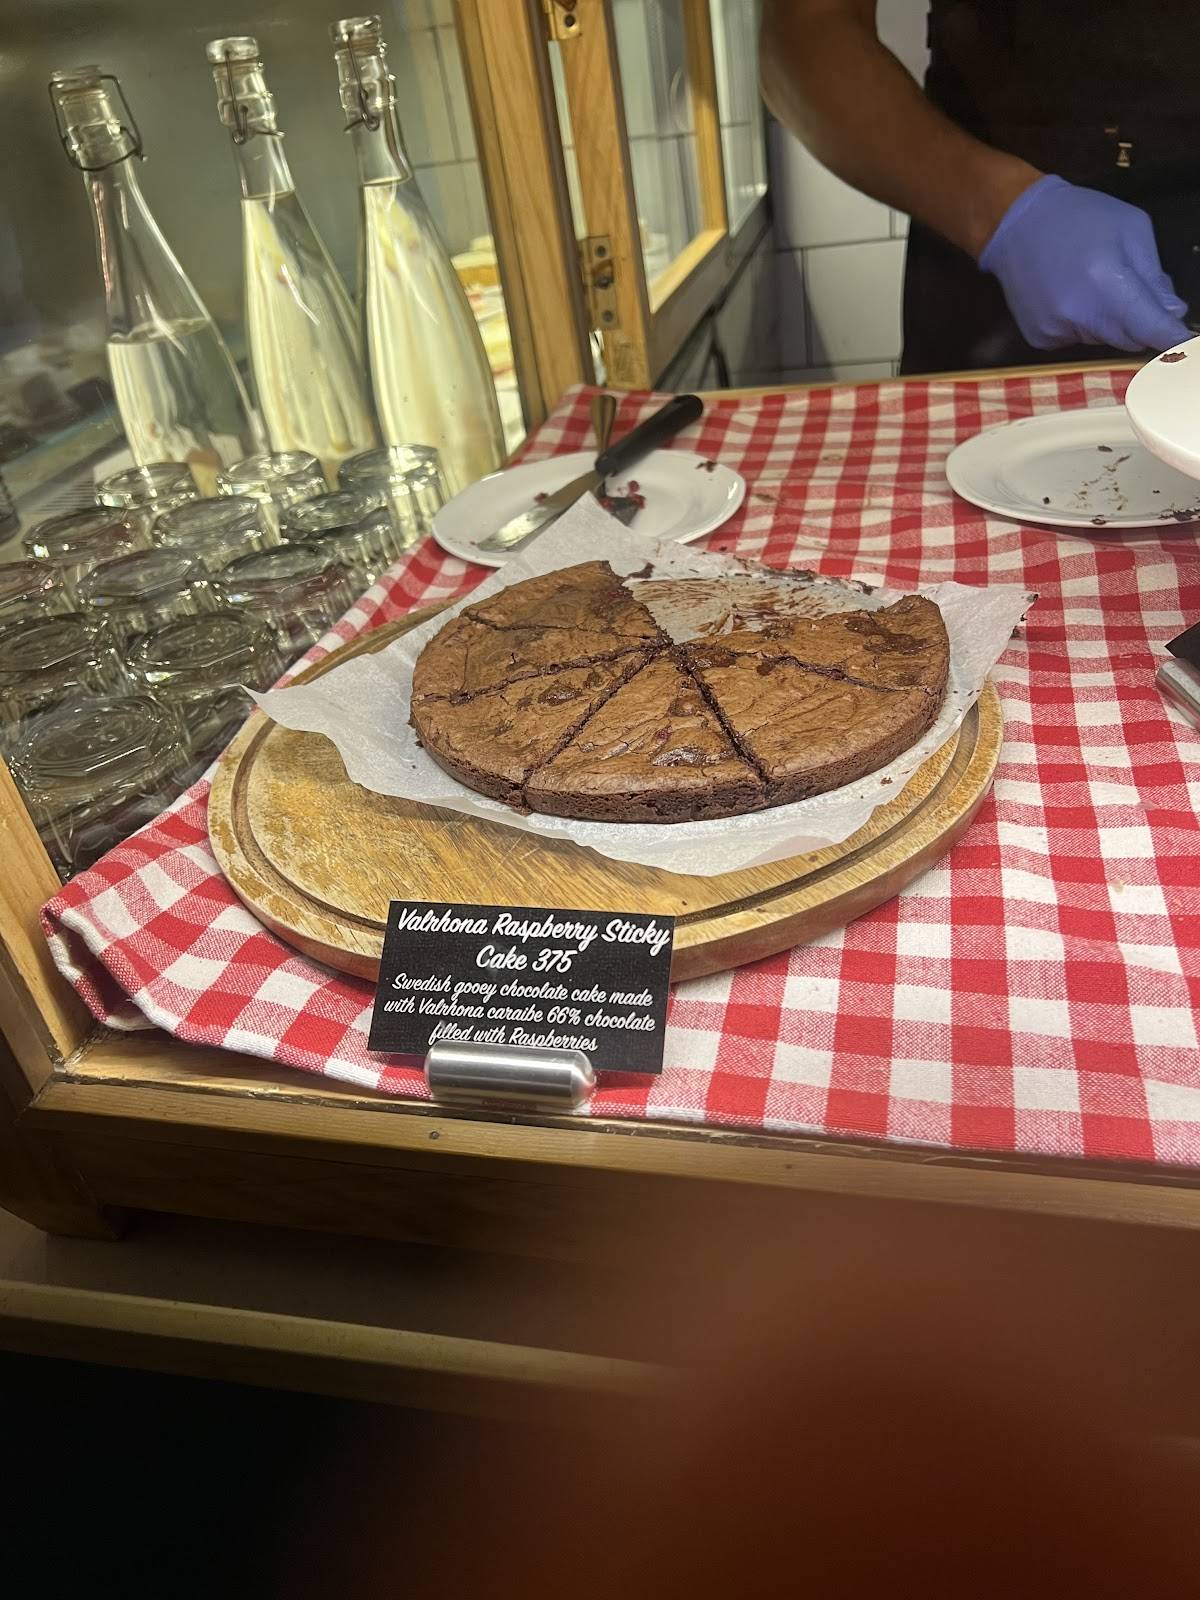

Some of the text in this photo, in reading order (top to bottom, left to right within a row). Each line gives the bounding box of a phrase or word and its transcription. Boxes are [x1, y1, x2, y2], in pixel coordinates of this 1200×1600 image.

[398, 908, 670, 956] Valrhona Raspberry Sticky
[476, 945, 577, 973] Cake 375
[392, 973, 653, 1007] Swedish gooey chocolate cake made
[384, 997, 655, 1031] with Valrhona caraibe 66% chocolate
[428, 1023, 598, 1051] filled with Raspberries
